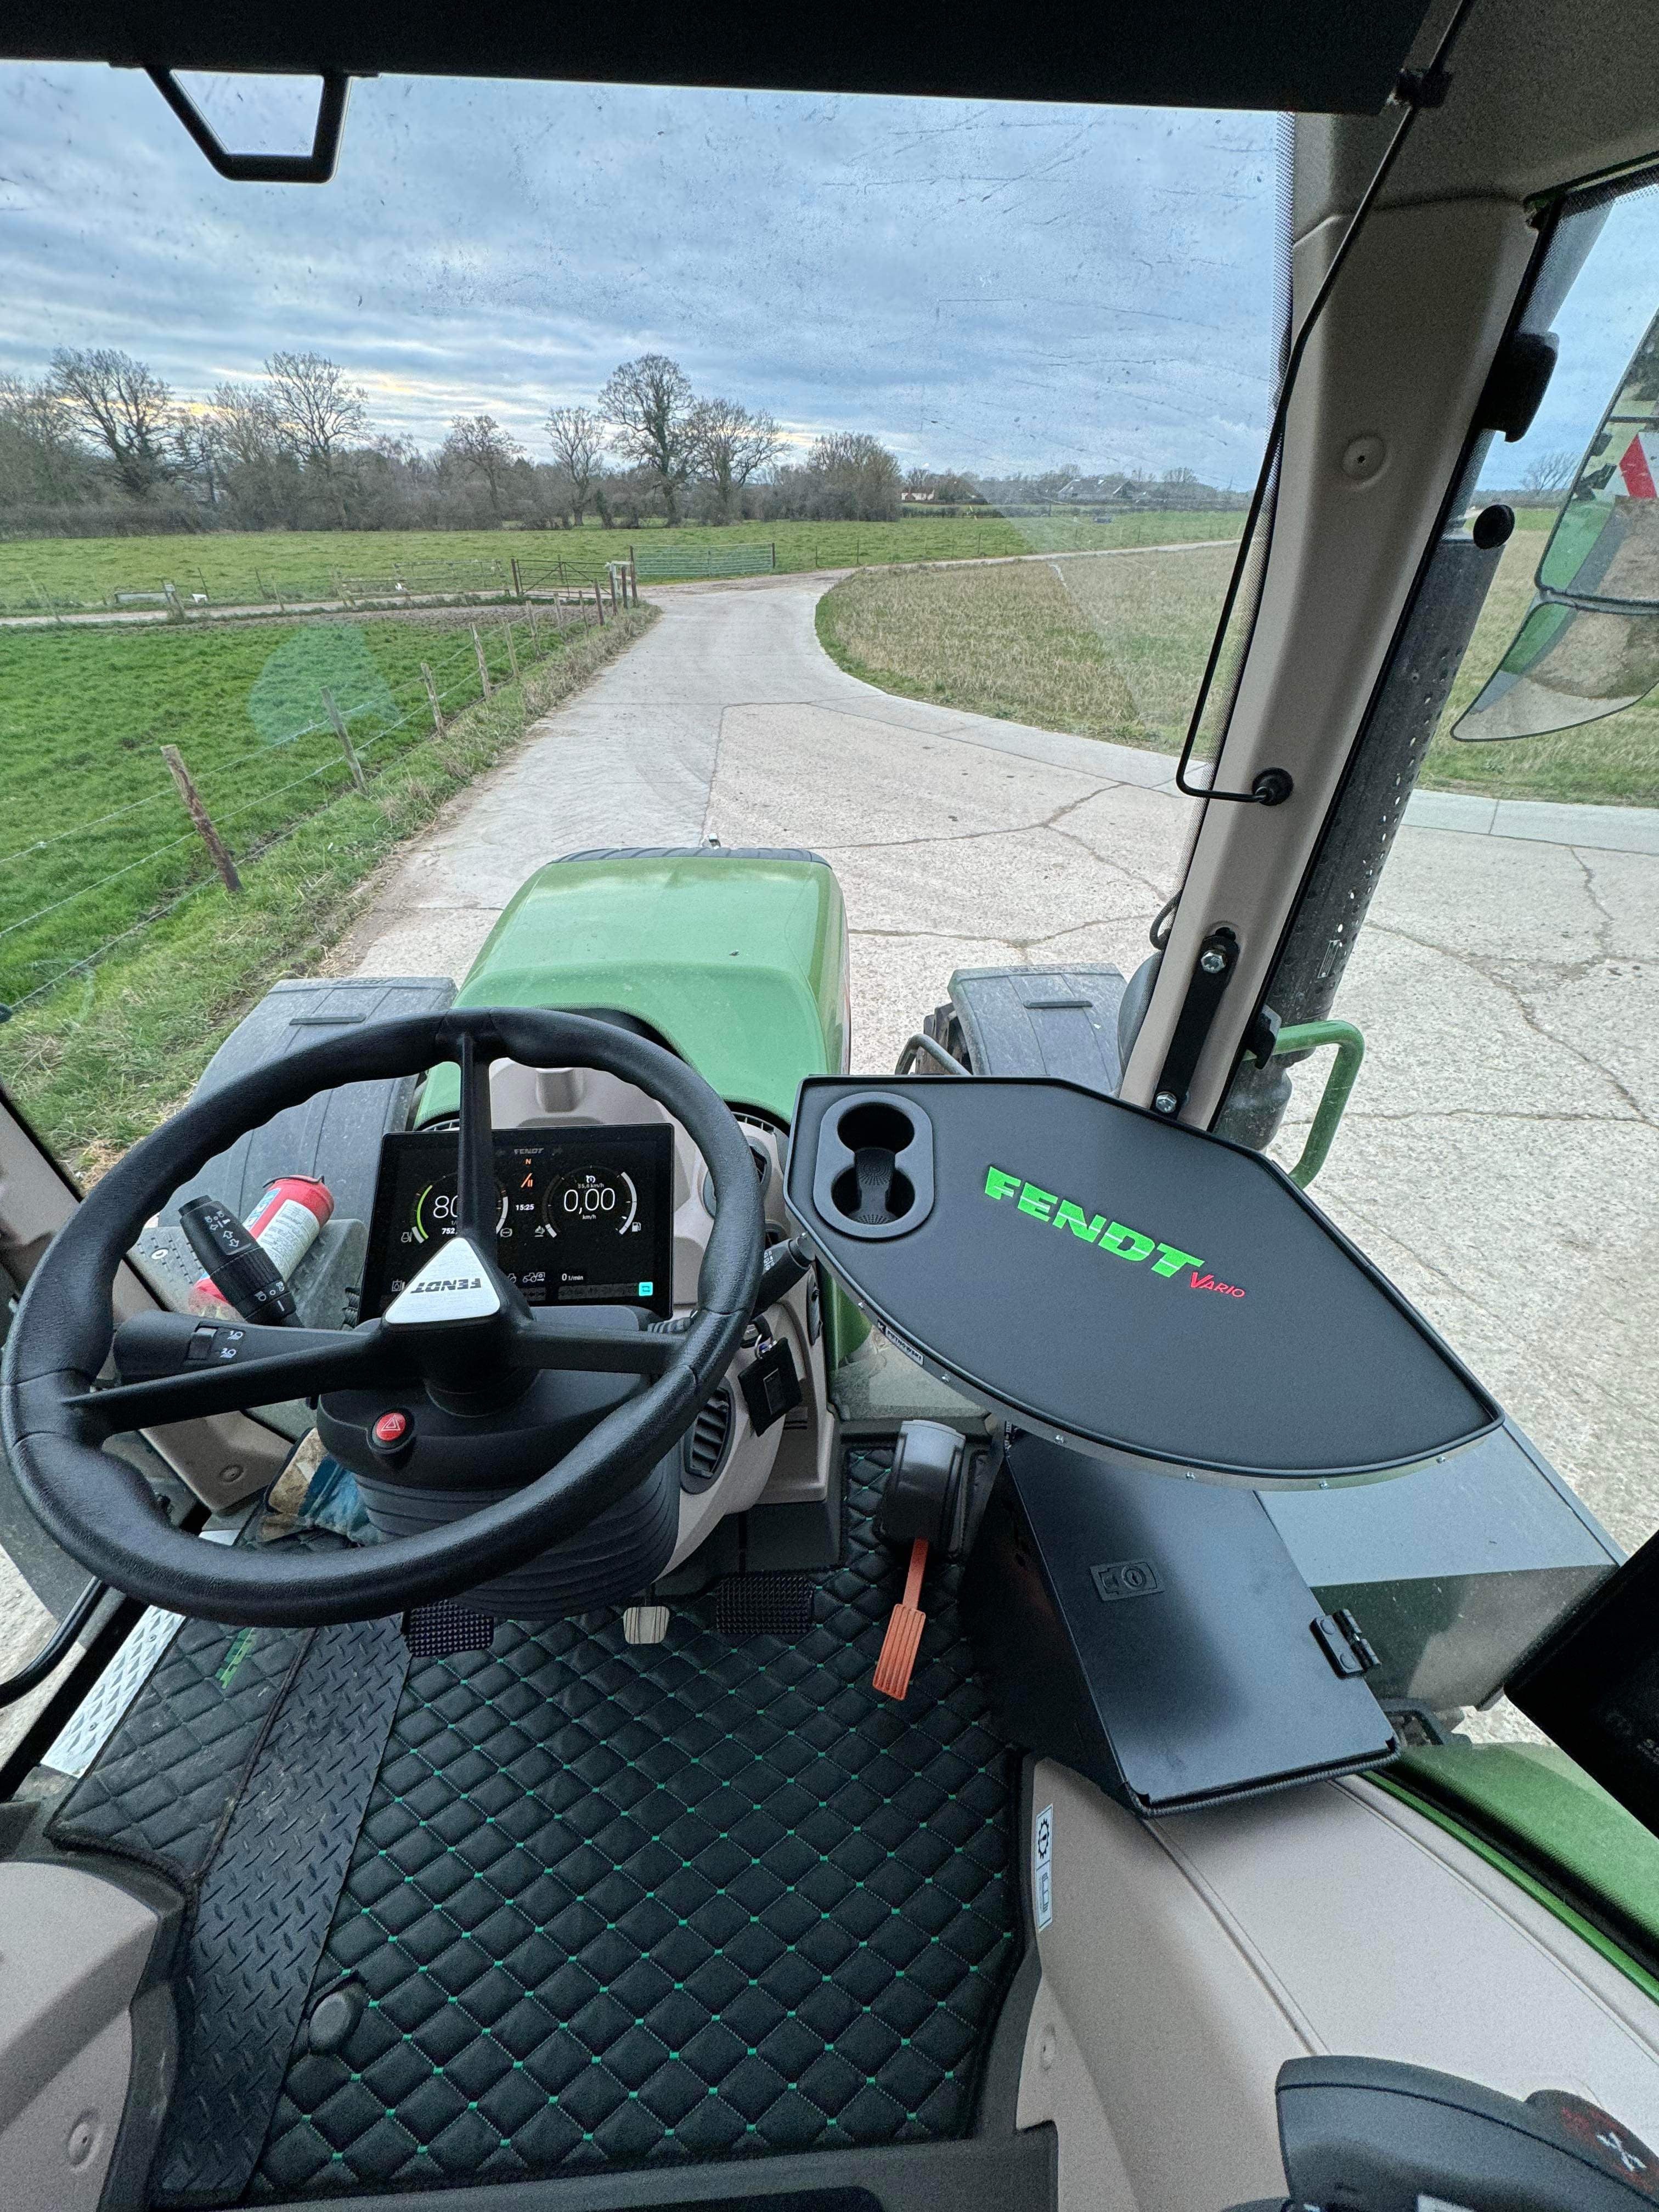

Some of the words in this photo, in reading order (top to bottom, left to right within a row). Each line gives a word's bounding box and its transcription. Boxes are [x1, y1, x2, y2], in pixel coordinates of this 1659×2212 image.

[564, 1188, 616, 1215] 0,00
[984, 1166, 1205, 1278] FENDT
[410, 1278, 481, 1294] FENDT
